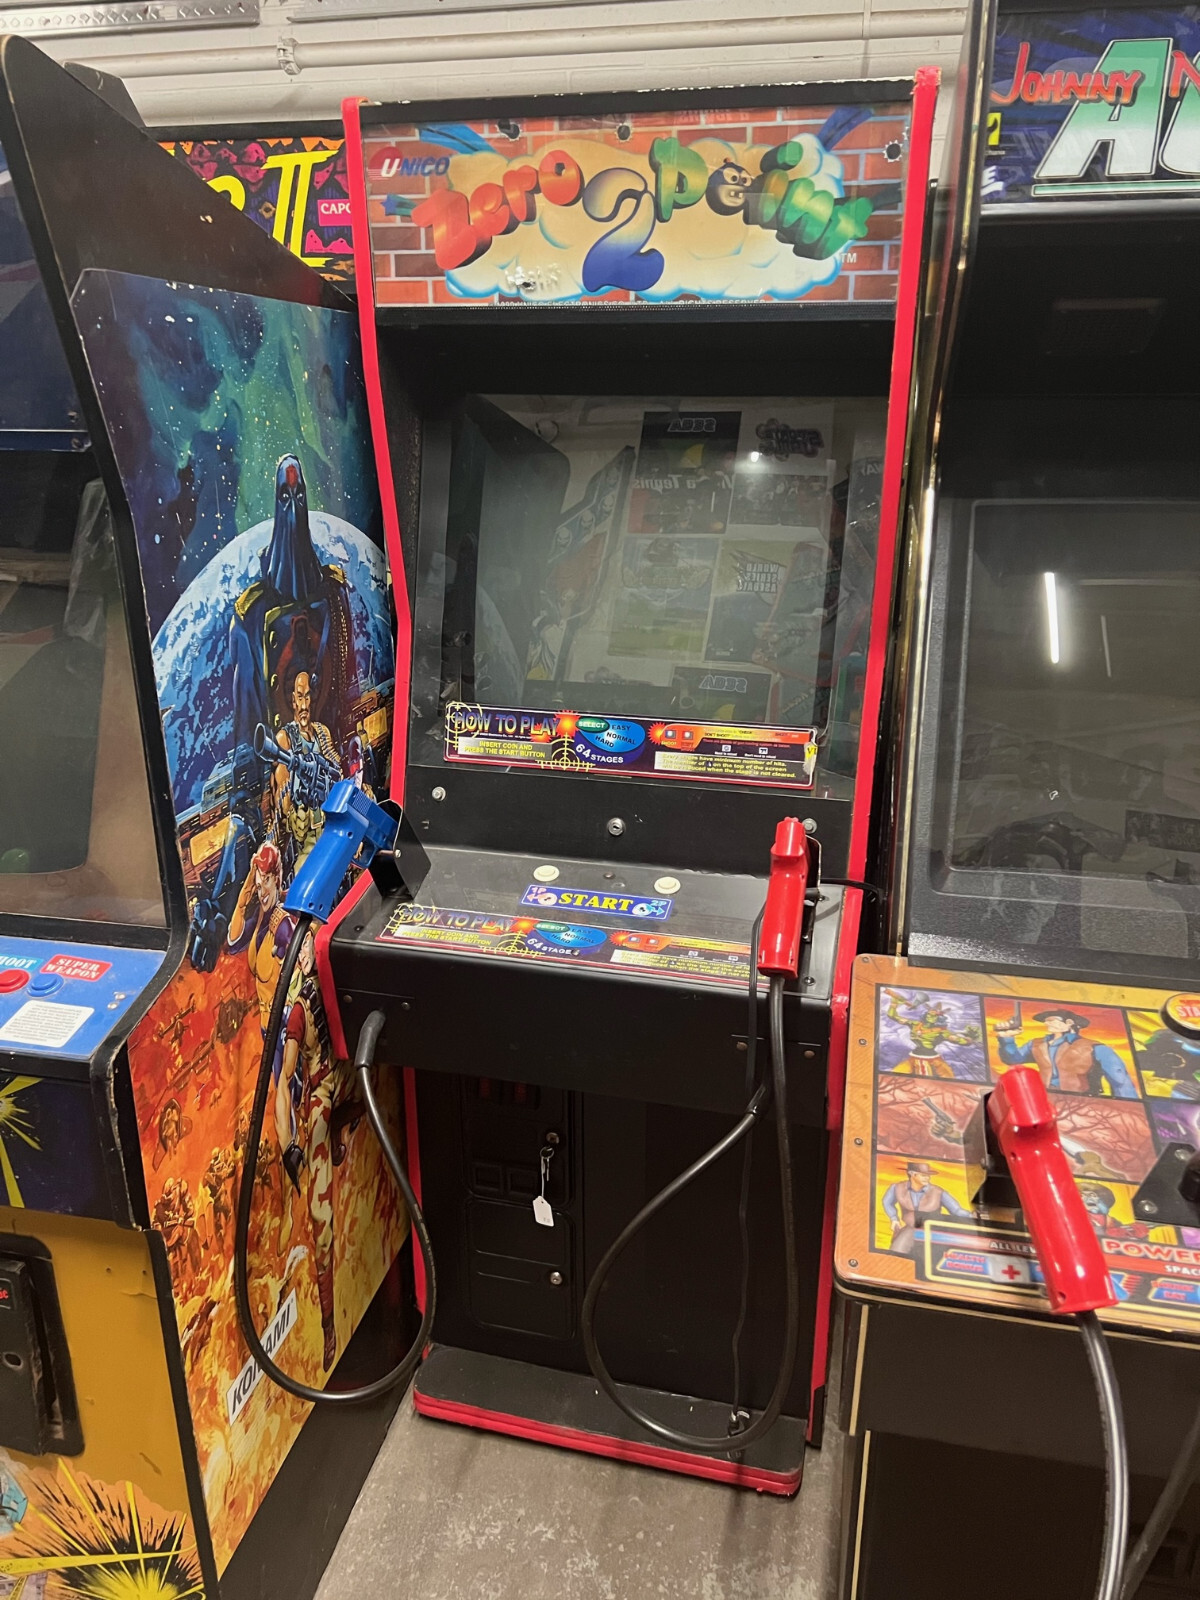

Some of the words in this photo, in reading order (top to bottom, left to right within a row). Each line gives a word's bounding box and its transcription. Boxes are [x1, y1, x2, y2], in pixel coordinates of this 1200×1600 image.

[989, 41, 1142, 104] JOHNNY
[379, 155, 450, 178] UNICO
[581, 166, 665, 293] 2
[841, 252, 858, 264] TM
[453, 711, 492, 732] HOW
[495, 714, 517, 734] TO
[519, 716, 561, 737] PLAY
[578, 721, 606, 729] SELECT
[611, 724, 632, 732] EASY
[595, 735, 615, 748] HARD
[606, 731, 636, 745] NORMAL
[464, 746, 485, 754] PRESS
[520, 750, 546, 758] BUTTON
[575, 743, 591, 758] 64
[590, 754, 624, 764] STAGES
[558, 892, 634, 912] START
[401, 908, 446, 924] HOW
[446, 912, 470, 927] TO
[470, 915, 514, 932] PLAY
[464, 937, 492, 946] BUTTON
[551, 933, 571, 944] HARD
[564, 932, 596, 944] NORMAL
[527, 938, 544, 949] 64
[541, 946, 580, 956] STAGE
[46, 963, 101, 979] WEAPON
[55, 958, 101, 972] SUPER
